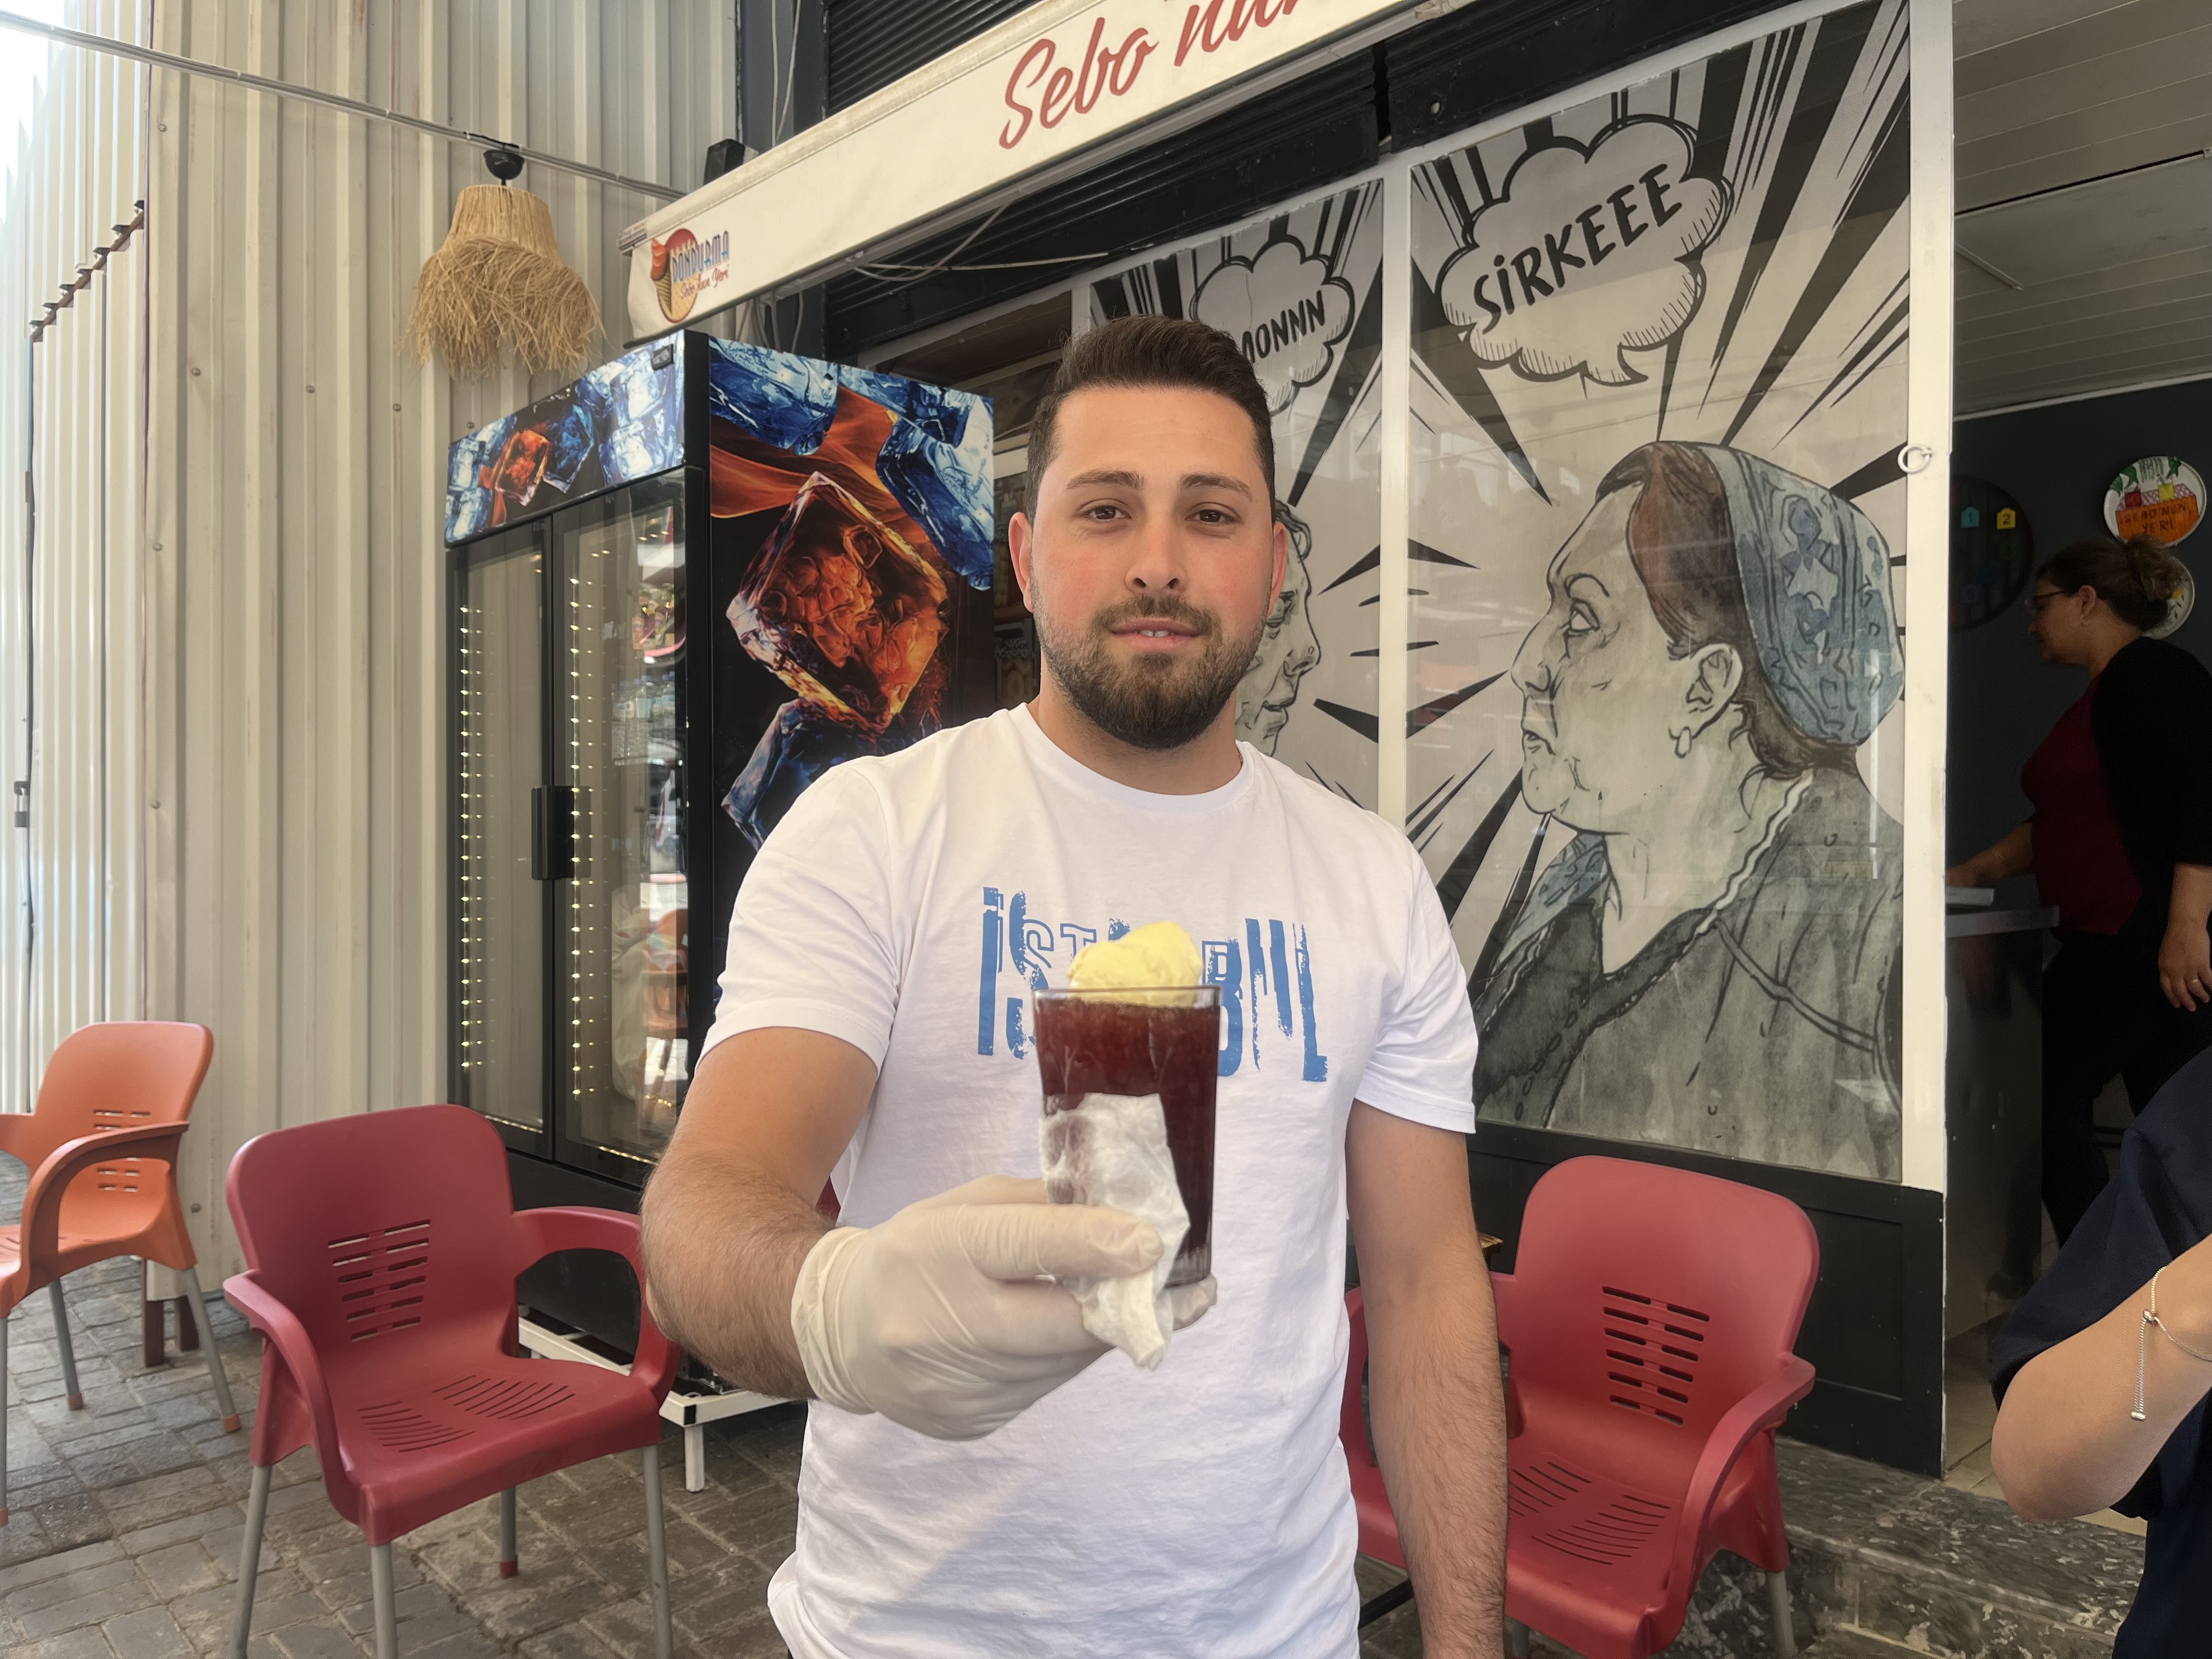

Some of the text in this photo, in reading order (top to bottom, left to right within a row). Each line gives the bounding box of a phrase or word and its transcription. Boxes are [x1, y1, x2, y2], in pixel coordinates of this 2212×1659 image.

[998, 17, 1159, 149] Sebo
[672, 230, 730, 285] DONDURMA
[1474, 163, 1683, 335] SİRKEEE
[2002, 513, 2011, 524] 2
